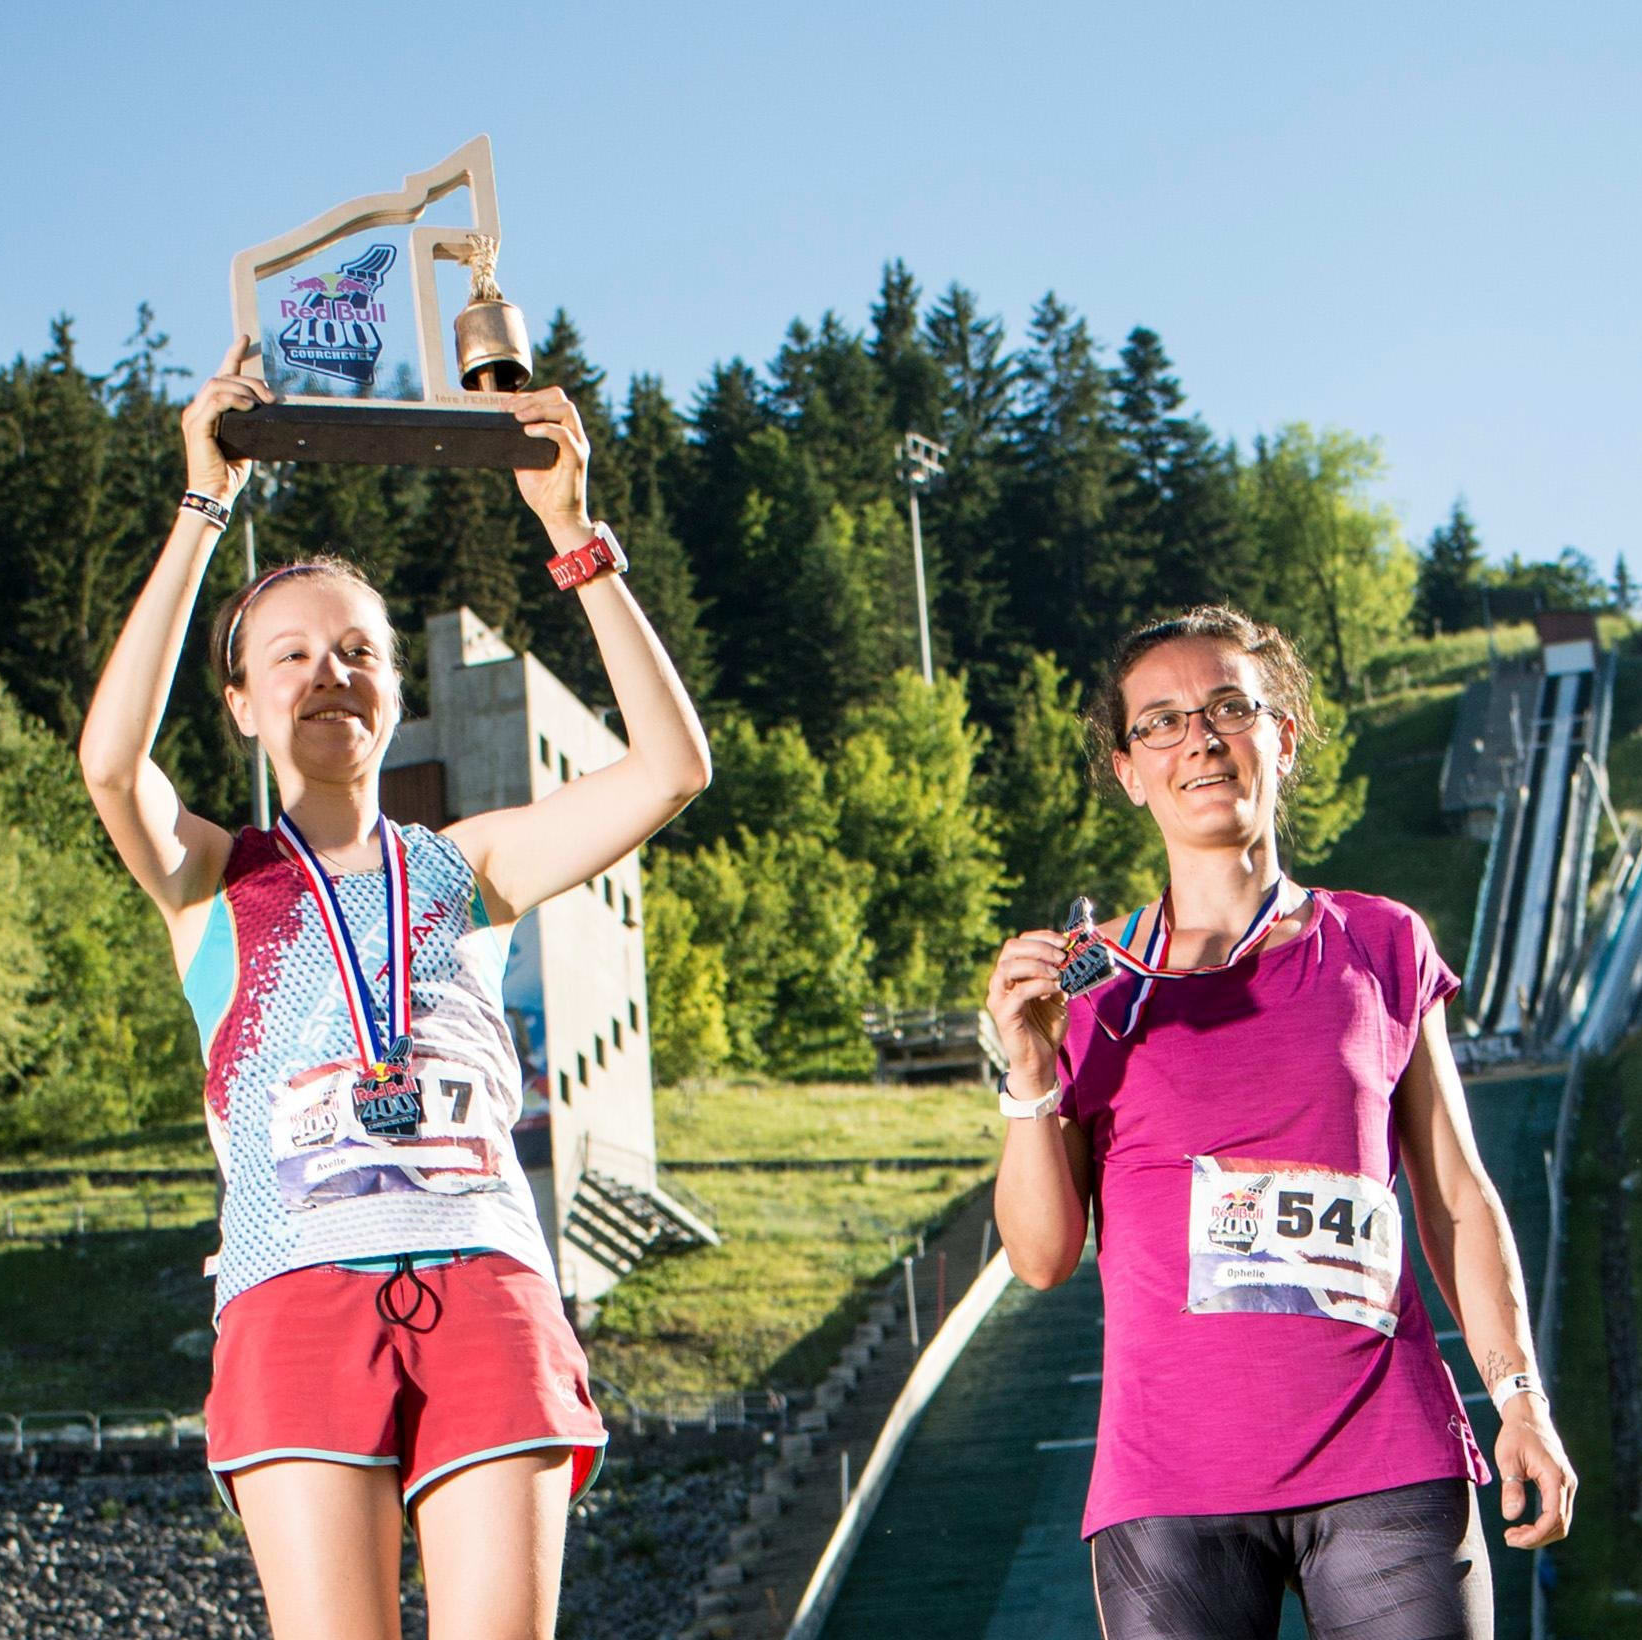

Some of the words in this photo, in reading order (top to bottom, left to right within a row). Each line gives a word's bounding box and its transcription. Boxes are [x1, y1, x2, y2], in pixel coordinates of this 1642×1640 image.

[280, 299, 333, 321] Red
[337, 300, 386, 323] Bull
[283, 318, 378, 350] 400
[290, 349, 374, 361] COURCHEVEL
[1062, 944, 1108, 988] 400
[354, 1083, 387, 1104] Red
[386, 1077, 417, 1097] Bull
[362, 1093, 416, 1120] 400
[294, 1112, 336, 1138] 400
[1211, 1206, 1237, 1218] Red
[1240, 1207, 1263, 1220] Bull
[1211, 1217, 1257, 1235] 400
